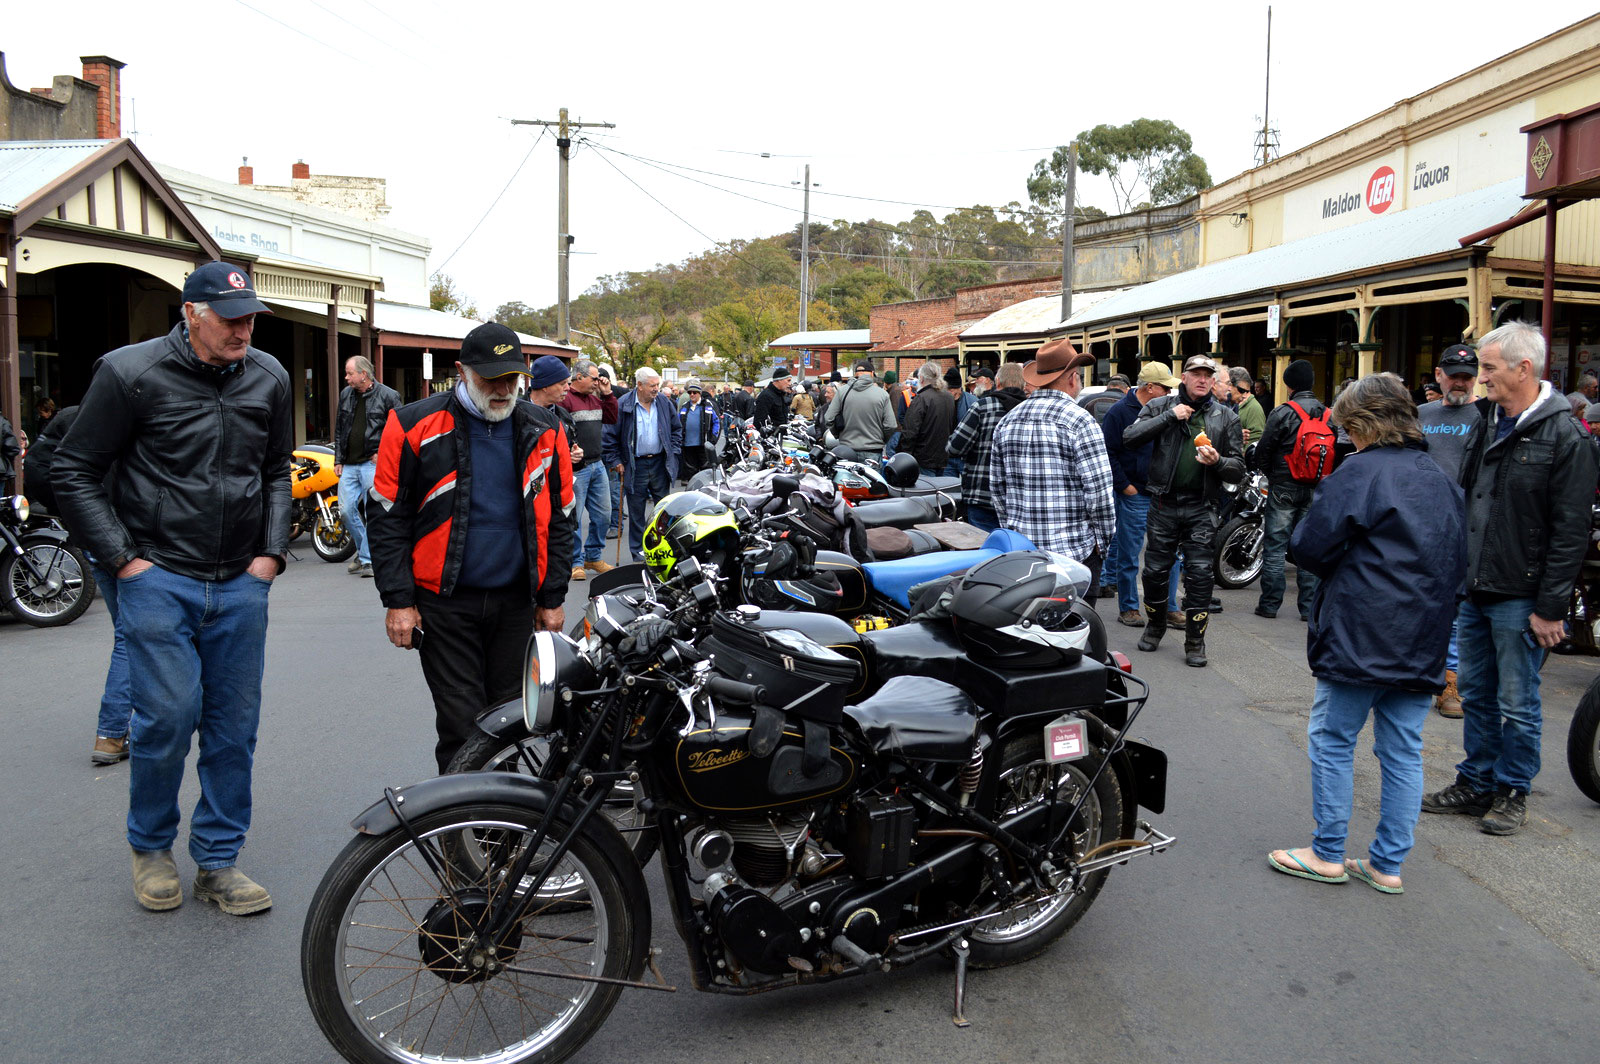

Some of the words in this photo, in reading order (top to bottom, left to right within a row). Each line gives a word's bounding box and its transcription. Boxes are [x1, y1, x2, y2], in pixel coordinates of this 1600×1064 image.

[1413, 165, 1450, 191] LIQUOR
[1415, 161, 1427, 173] plus
[1322, 192, 1361, 219] Maldon
[1368, 173, 1394, 208] IGA
[1422, 423, 1460, 436] Hurley
[688, 747, 750, 771] Velocette
